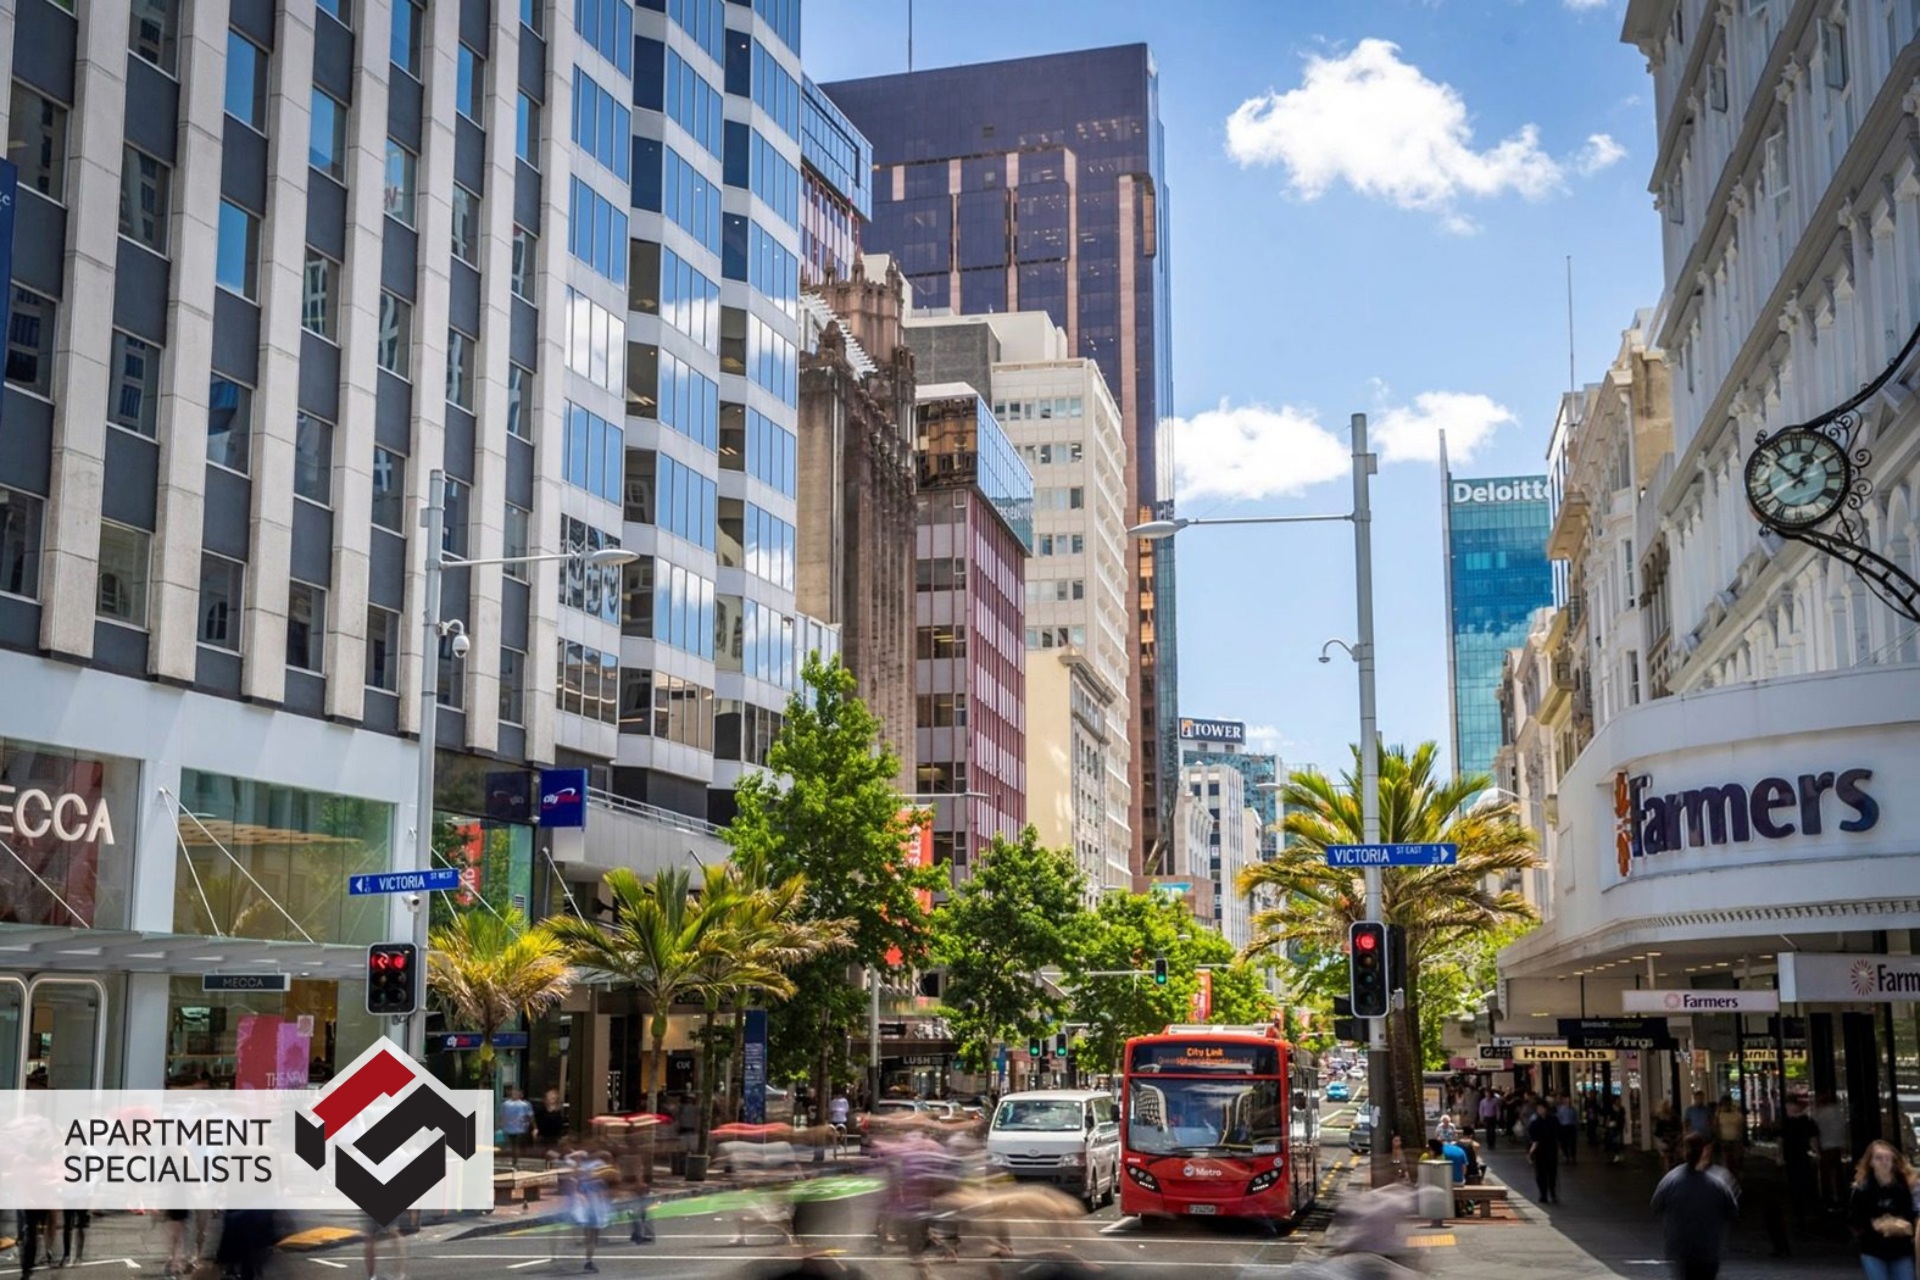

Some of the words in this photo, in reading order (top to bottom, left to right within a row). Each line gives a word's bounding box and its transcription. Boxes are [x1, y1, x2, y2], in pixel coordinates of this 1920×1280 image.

[1193, 723, 1242, 739] TOWER
[1628, 768, 1880, 858] Farmers
[1334, 847, 1390, 864] VICTORIA
[1396, 846, 1404, 855] ST
[1405, 845, 1423, 854] EAST
[378, 874, 426, 891] VICTORIA
[430, 872, 437, 880] ST
[438, 871, 453, 880] WEST
[222, 977, 264, 988] MECCA
[1877, 964, 1920, 992] Farm
[1683, 994, 1739, 1008] Farmers
[1187, 1047, 1204, 1057] City
[1523, 1048, 1607, 1060] Hannahs
[903, 1055, 931, 1065] LUSH
[1195, 1167, 1222, 1177] Metro
